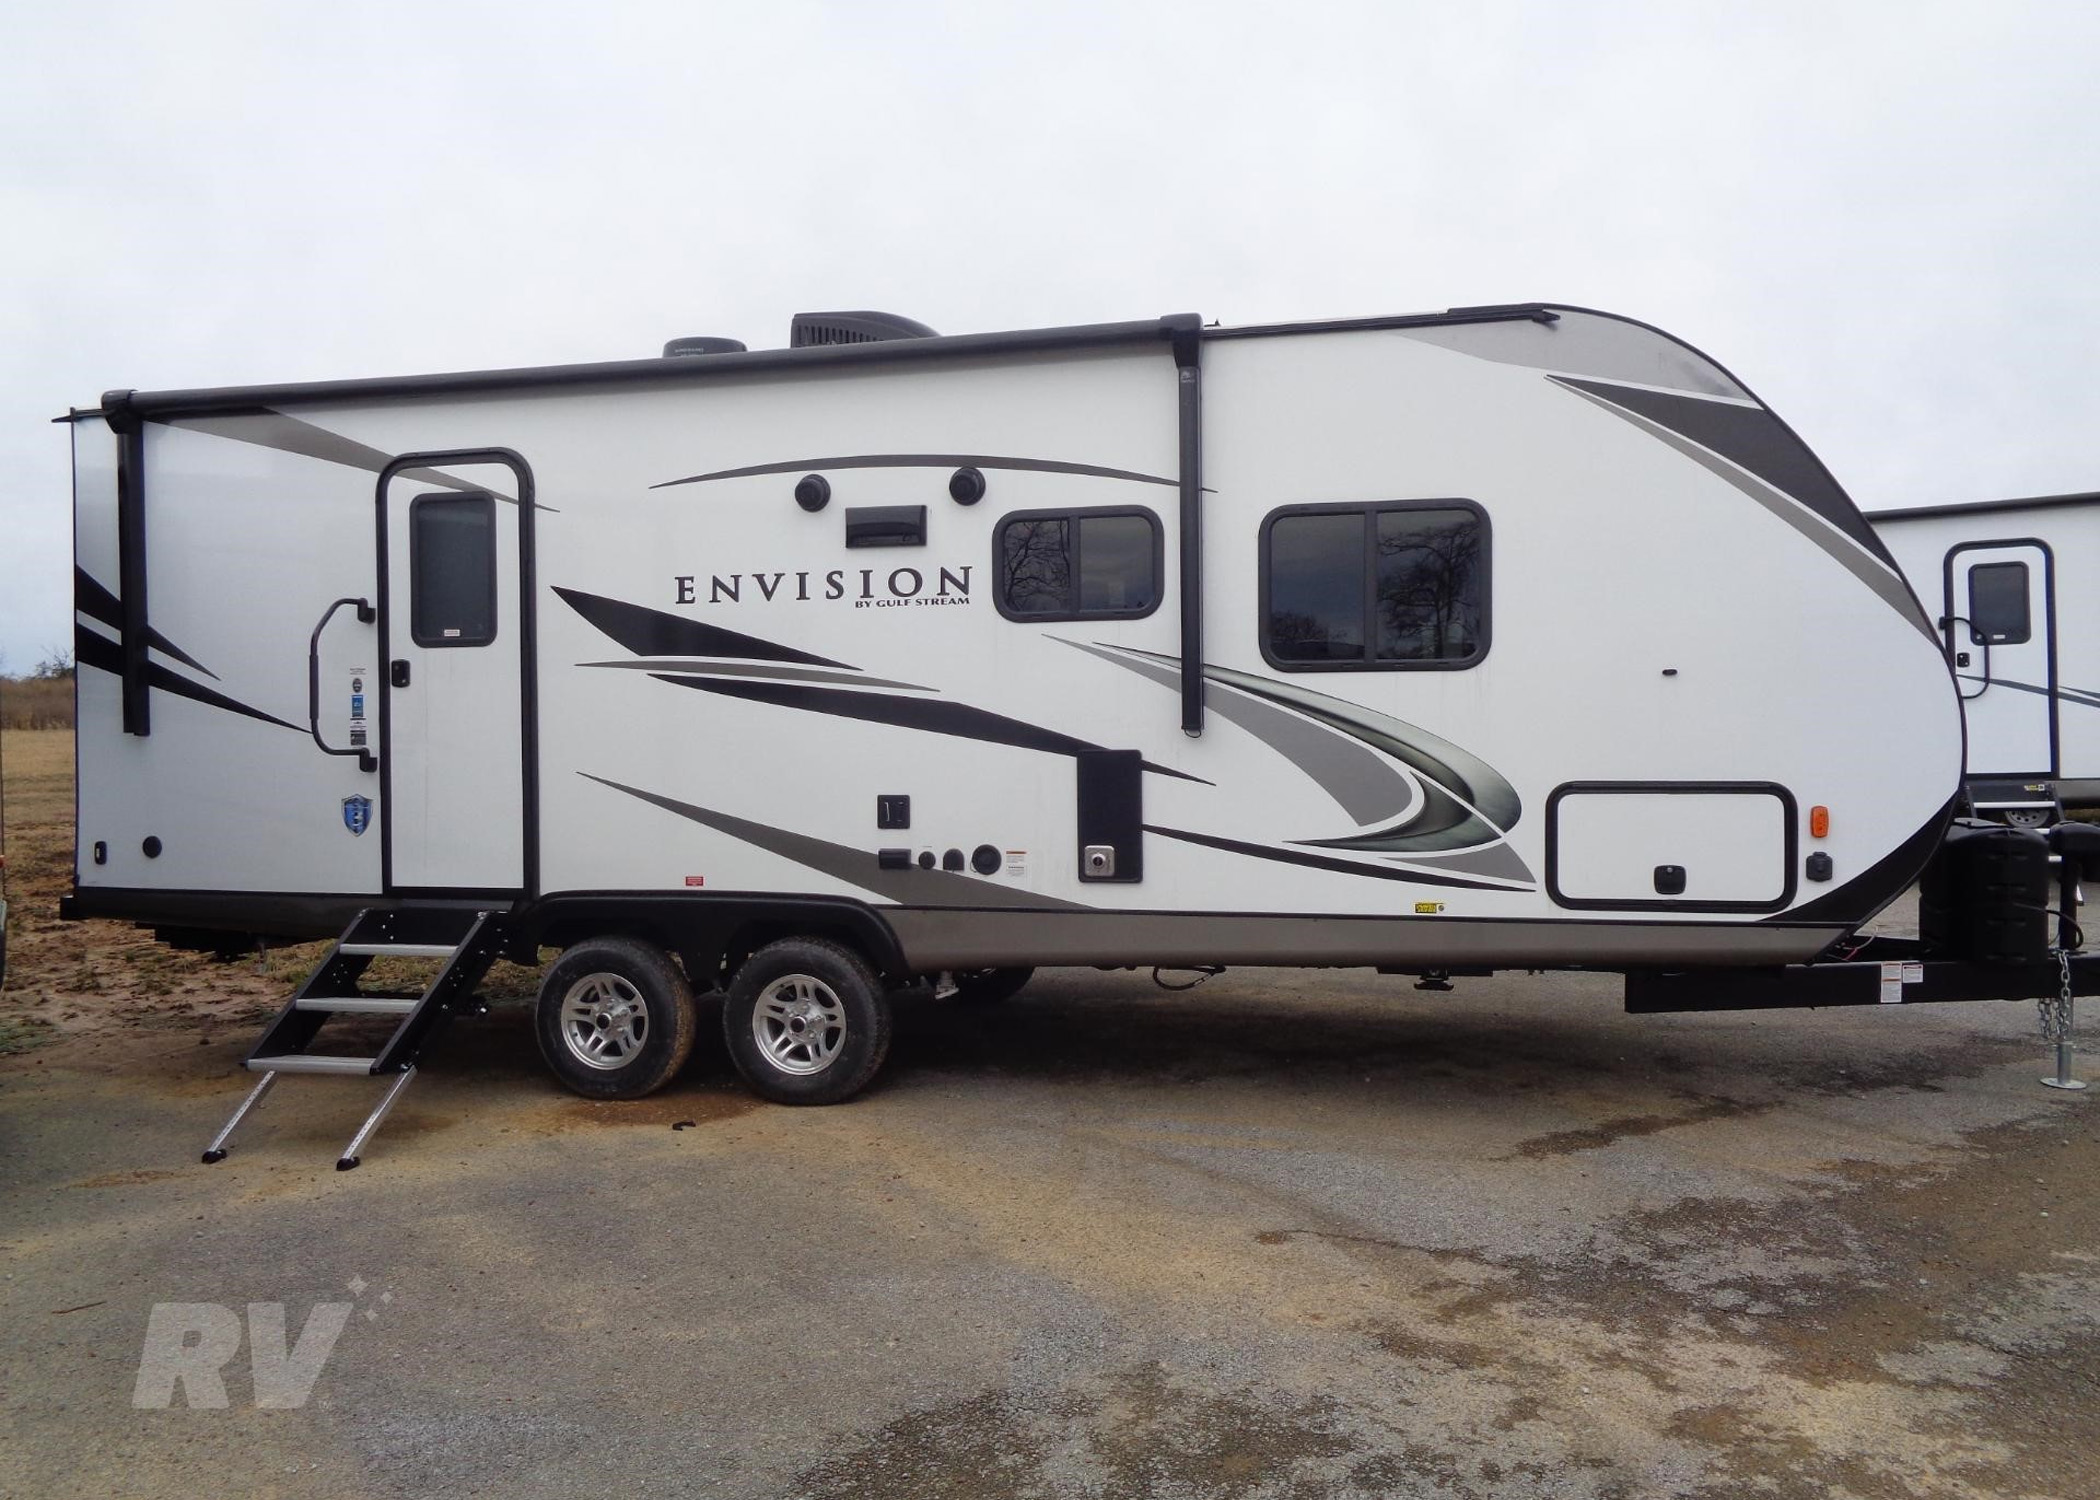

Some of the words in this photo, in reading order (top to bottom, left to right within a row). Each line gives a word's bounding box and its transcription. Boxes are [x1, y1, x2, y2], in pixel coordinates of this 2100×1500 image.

[674, 565, 973, 605] ENVISION
[855, 600, 872, 609] BY
[875, 598, 912, 608] GULF
[915, 597, 970, 607] STREAM
